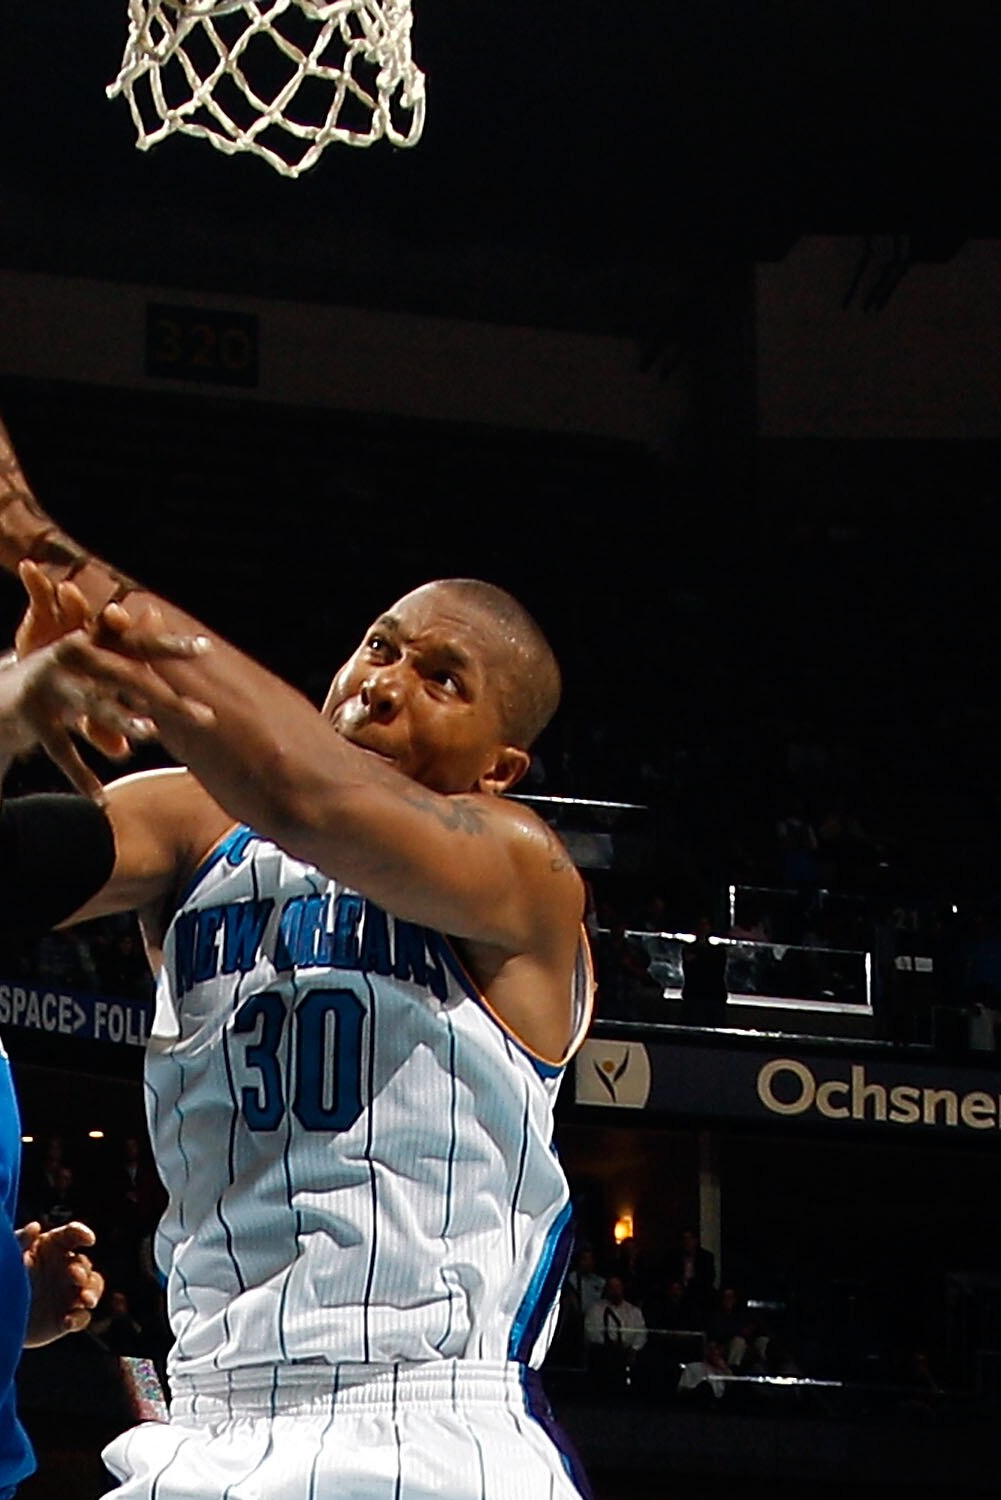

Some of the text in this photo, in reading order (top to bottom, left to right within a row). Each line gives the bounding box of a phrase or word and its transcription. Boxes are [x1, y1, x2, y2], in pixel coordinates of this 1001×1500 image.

[155, 319, 251, 371] 320
[175, 894, 448, 1002] NEW ORLEANS
[233, 987, 368, 1132] 30
